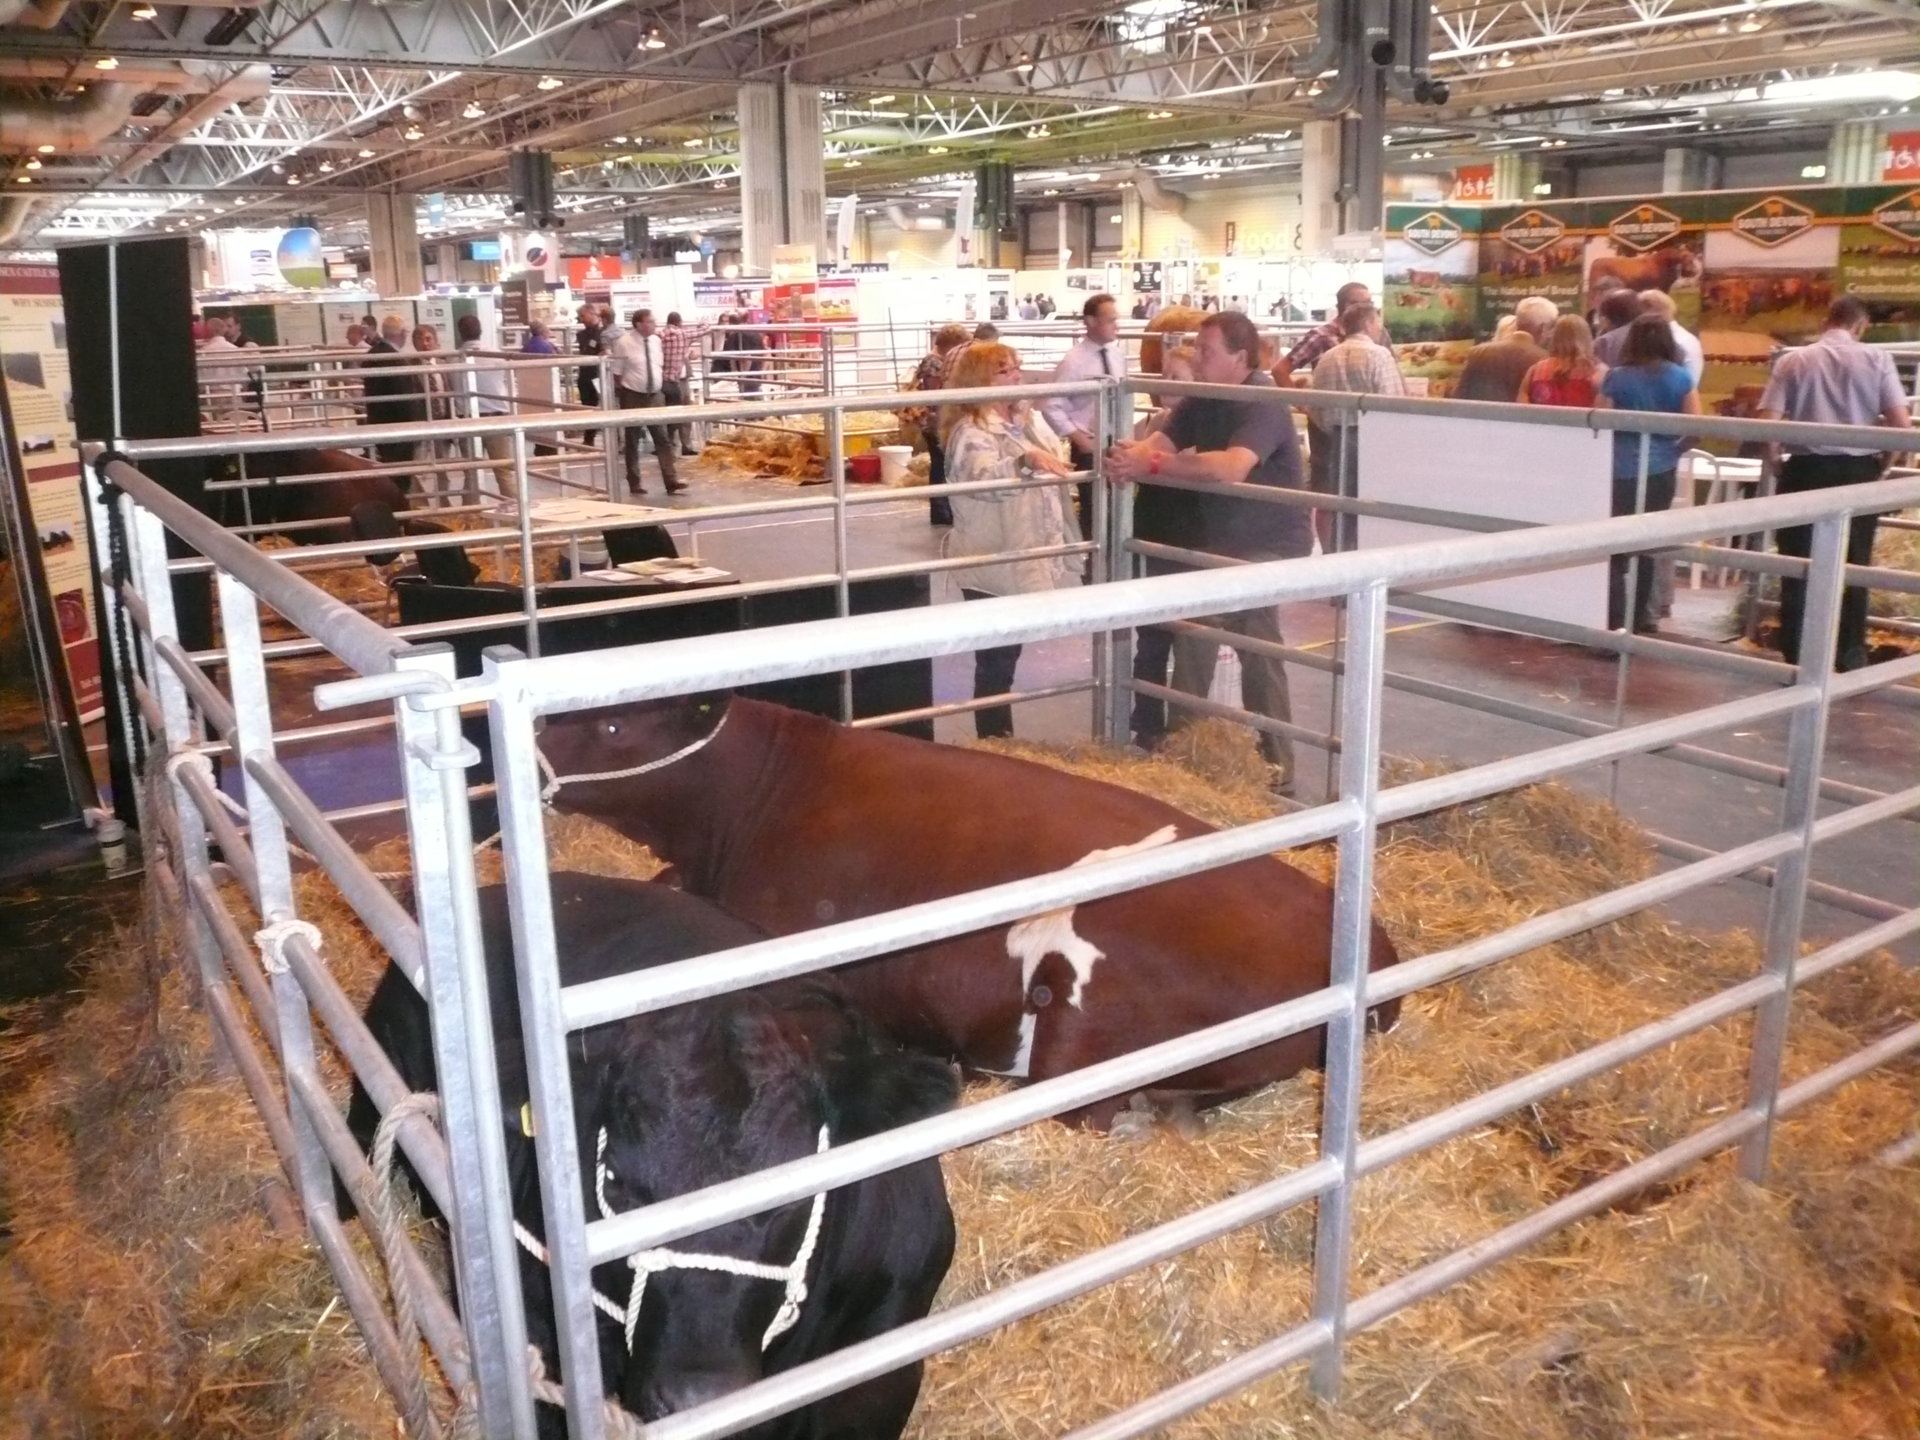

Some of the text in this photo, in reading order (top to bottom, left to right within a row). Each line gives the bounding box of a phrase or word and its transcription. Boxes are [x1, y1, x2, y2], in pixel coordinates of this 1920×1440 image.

[1738, 215, 1810, 229] SOUTH DEVONS
[1505, 227, 1560, 238] SOUTH DEVONS
[1614, 222, 1676, 234] SOUTH DEVONS
[1408, 229, 1458, 239] SOUTH DEVONS
[1482, 286, 1499, 296] The
[1500, 286, 1528, 296] Native
[1551, 285, 1579, 295] Breed
